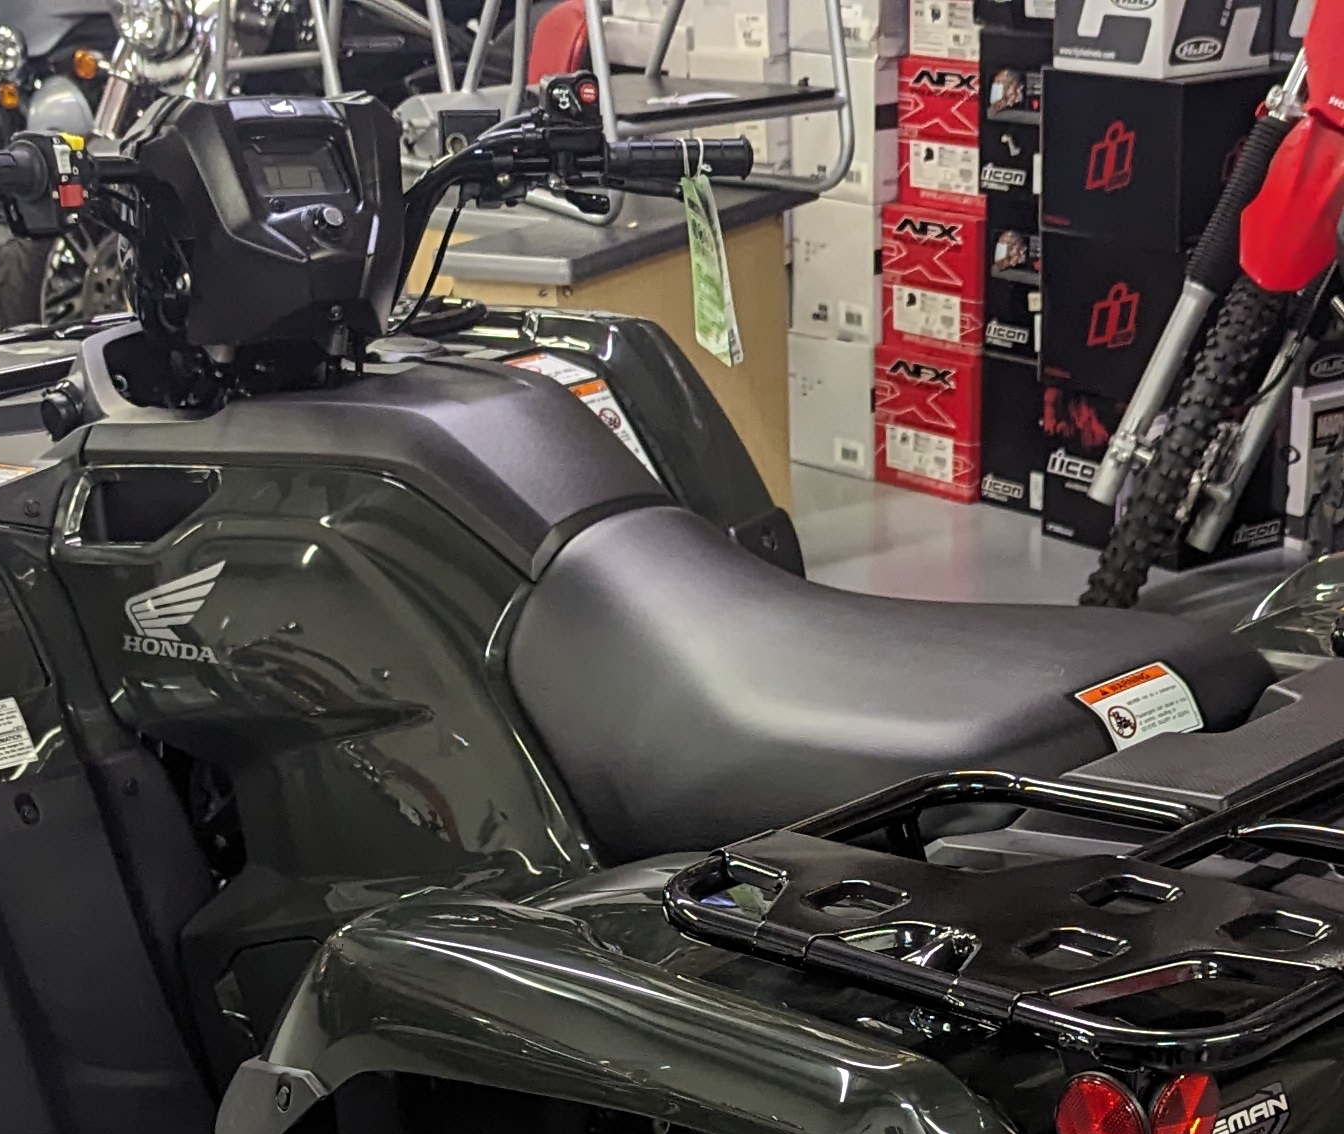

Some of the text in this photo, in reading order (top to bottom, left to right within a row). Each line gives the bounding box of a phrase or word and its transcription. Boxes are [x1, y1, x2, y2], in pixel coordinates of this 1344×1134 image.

[912, 69, 977, 91] AFX
[895, 217, 961, 242] AFX
[889, 360, 955, 387] AFX
[1047, 448, 1099, 482] ico
[122, 635, 219, 664] HONDA
